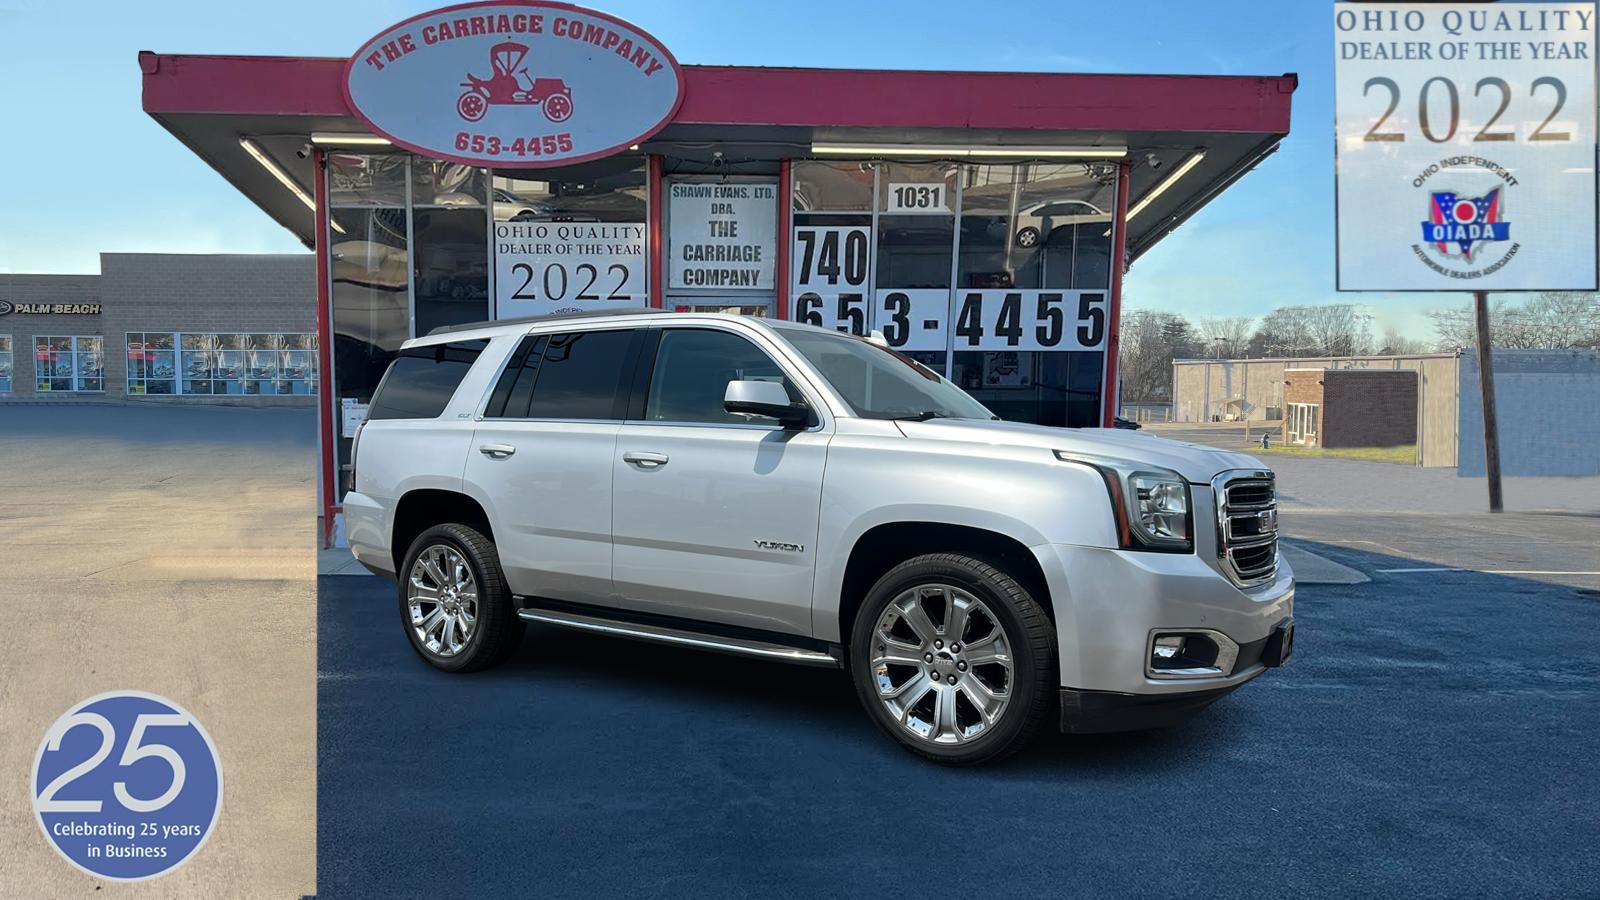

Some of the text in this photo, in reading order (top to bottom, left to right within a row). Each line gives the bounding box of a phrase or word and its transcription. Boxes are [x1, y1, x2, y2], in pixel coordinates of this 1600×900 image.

[1336, 10, 1594, 35] OHIO QUALITY
[366, 14, 664, 77] THE CARRIAGE COMPANY
[1340, 42, 1589, 60] DEALER OF THE YEAR
[1363, 76, 1571, 143] 2022
[454, 132, 574, 157] 653-4455
[1412, 156, 1519, 188] OHIO INDEPENDENT
[673, 186, 712, 198] SHAWN
[754, 187, 775, 200] LTD.
[894, 186, 941, 209] 1031
[711, 203, 736, 215] DBA.
[497, 226, 644, 241] OHIO QUALITY
[708, 221, 738, 238] THE
[1432, 224, 1495, 241] OIADA
[499, 243, 642, 256] DEALER OF THE YEAR
[683, 244, 762, 262] CARRIAGE
[797, 230, 868, 286] 740
[1450, 269, 1483, 280] DEALERS
[1482, 242, 1521, 276] ASSOCIATION
[511, 263, 632, 301] 2022
[683, 268, 761, 286] COMPANY
[14, 304, 100, 314] PALM BEACH
